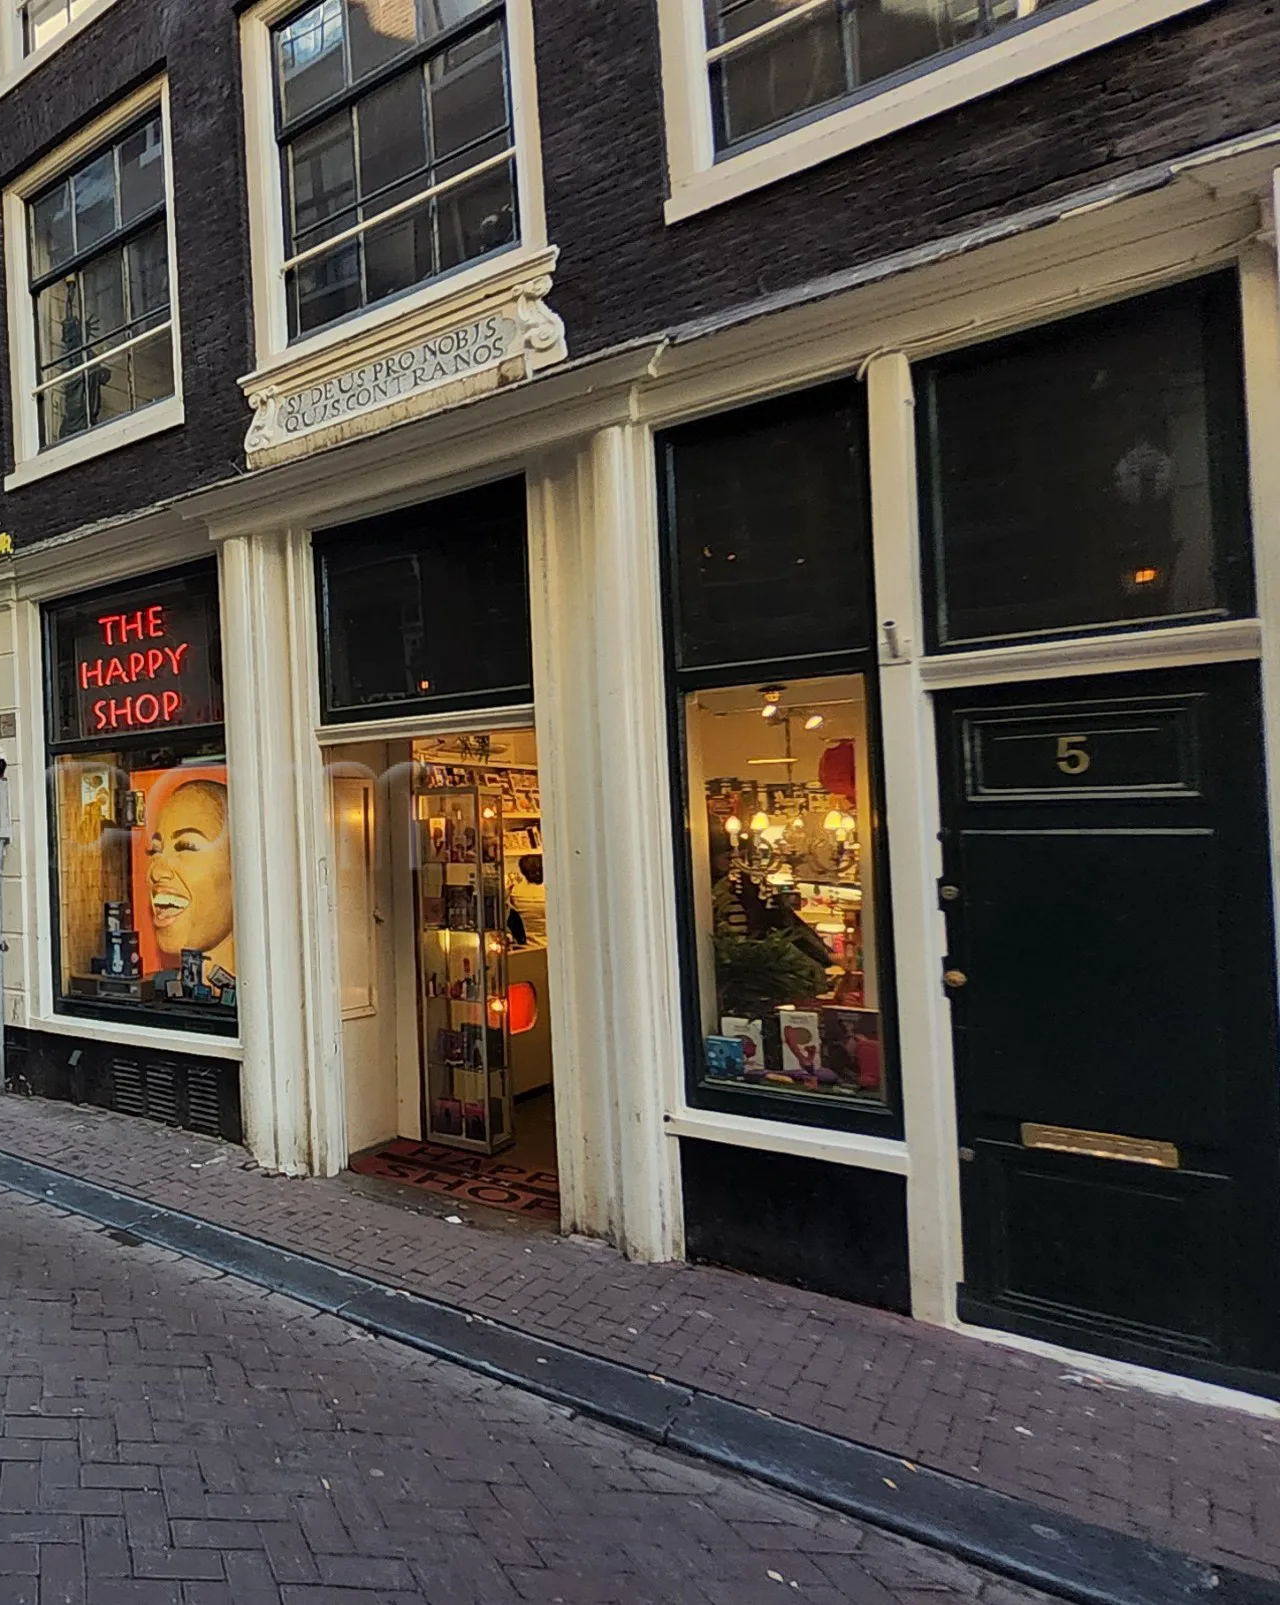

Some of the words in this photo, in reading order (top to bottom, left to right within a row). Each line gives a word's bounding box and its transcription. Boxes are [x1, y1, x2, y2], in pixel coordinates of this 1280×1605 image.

[452, 336, 504, 374] NOS
[311, 369, 366, 407] DEUS
[372, 351, 415, 382] PRO
[98, 605, 164, 646] THE
[81, 643, 188, 690] HAPPY
[94, 690, 180, 729] SHOP
[1056, 735, 1090, 774] 5
[408, 1147, 558, 1184] HAPP
[377, 1163, 560, 1211] SHOP
